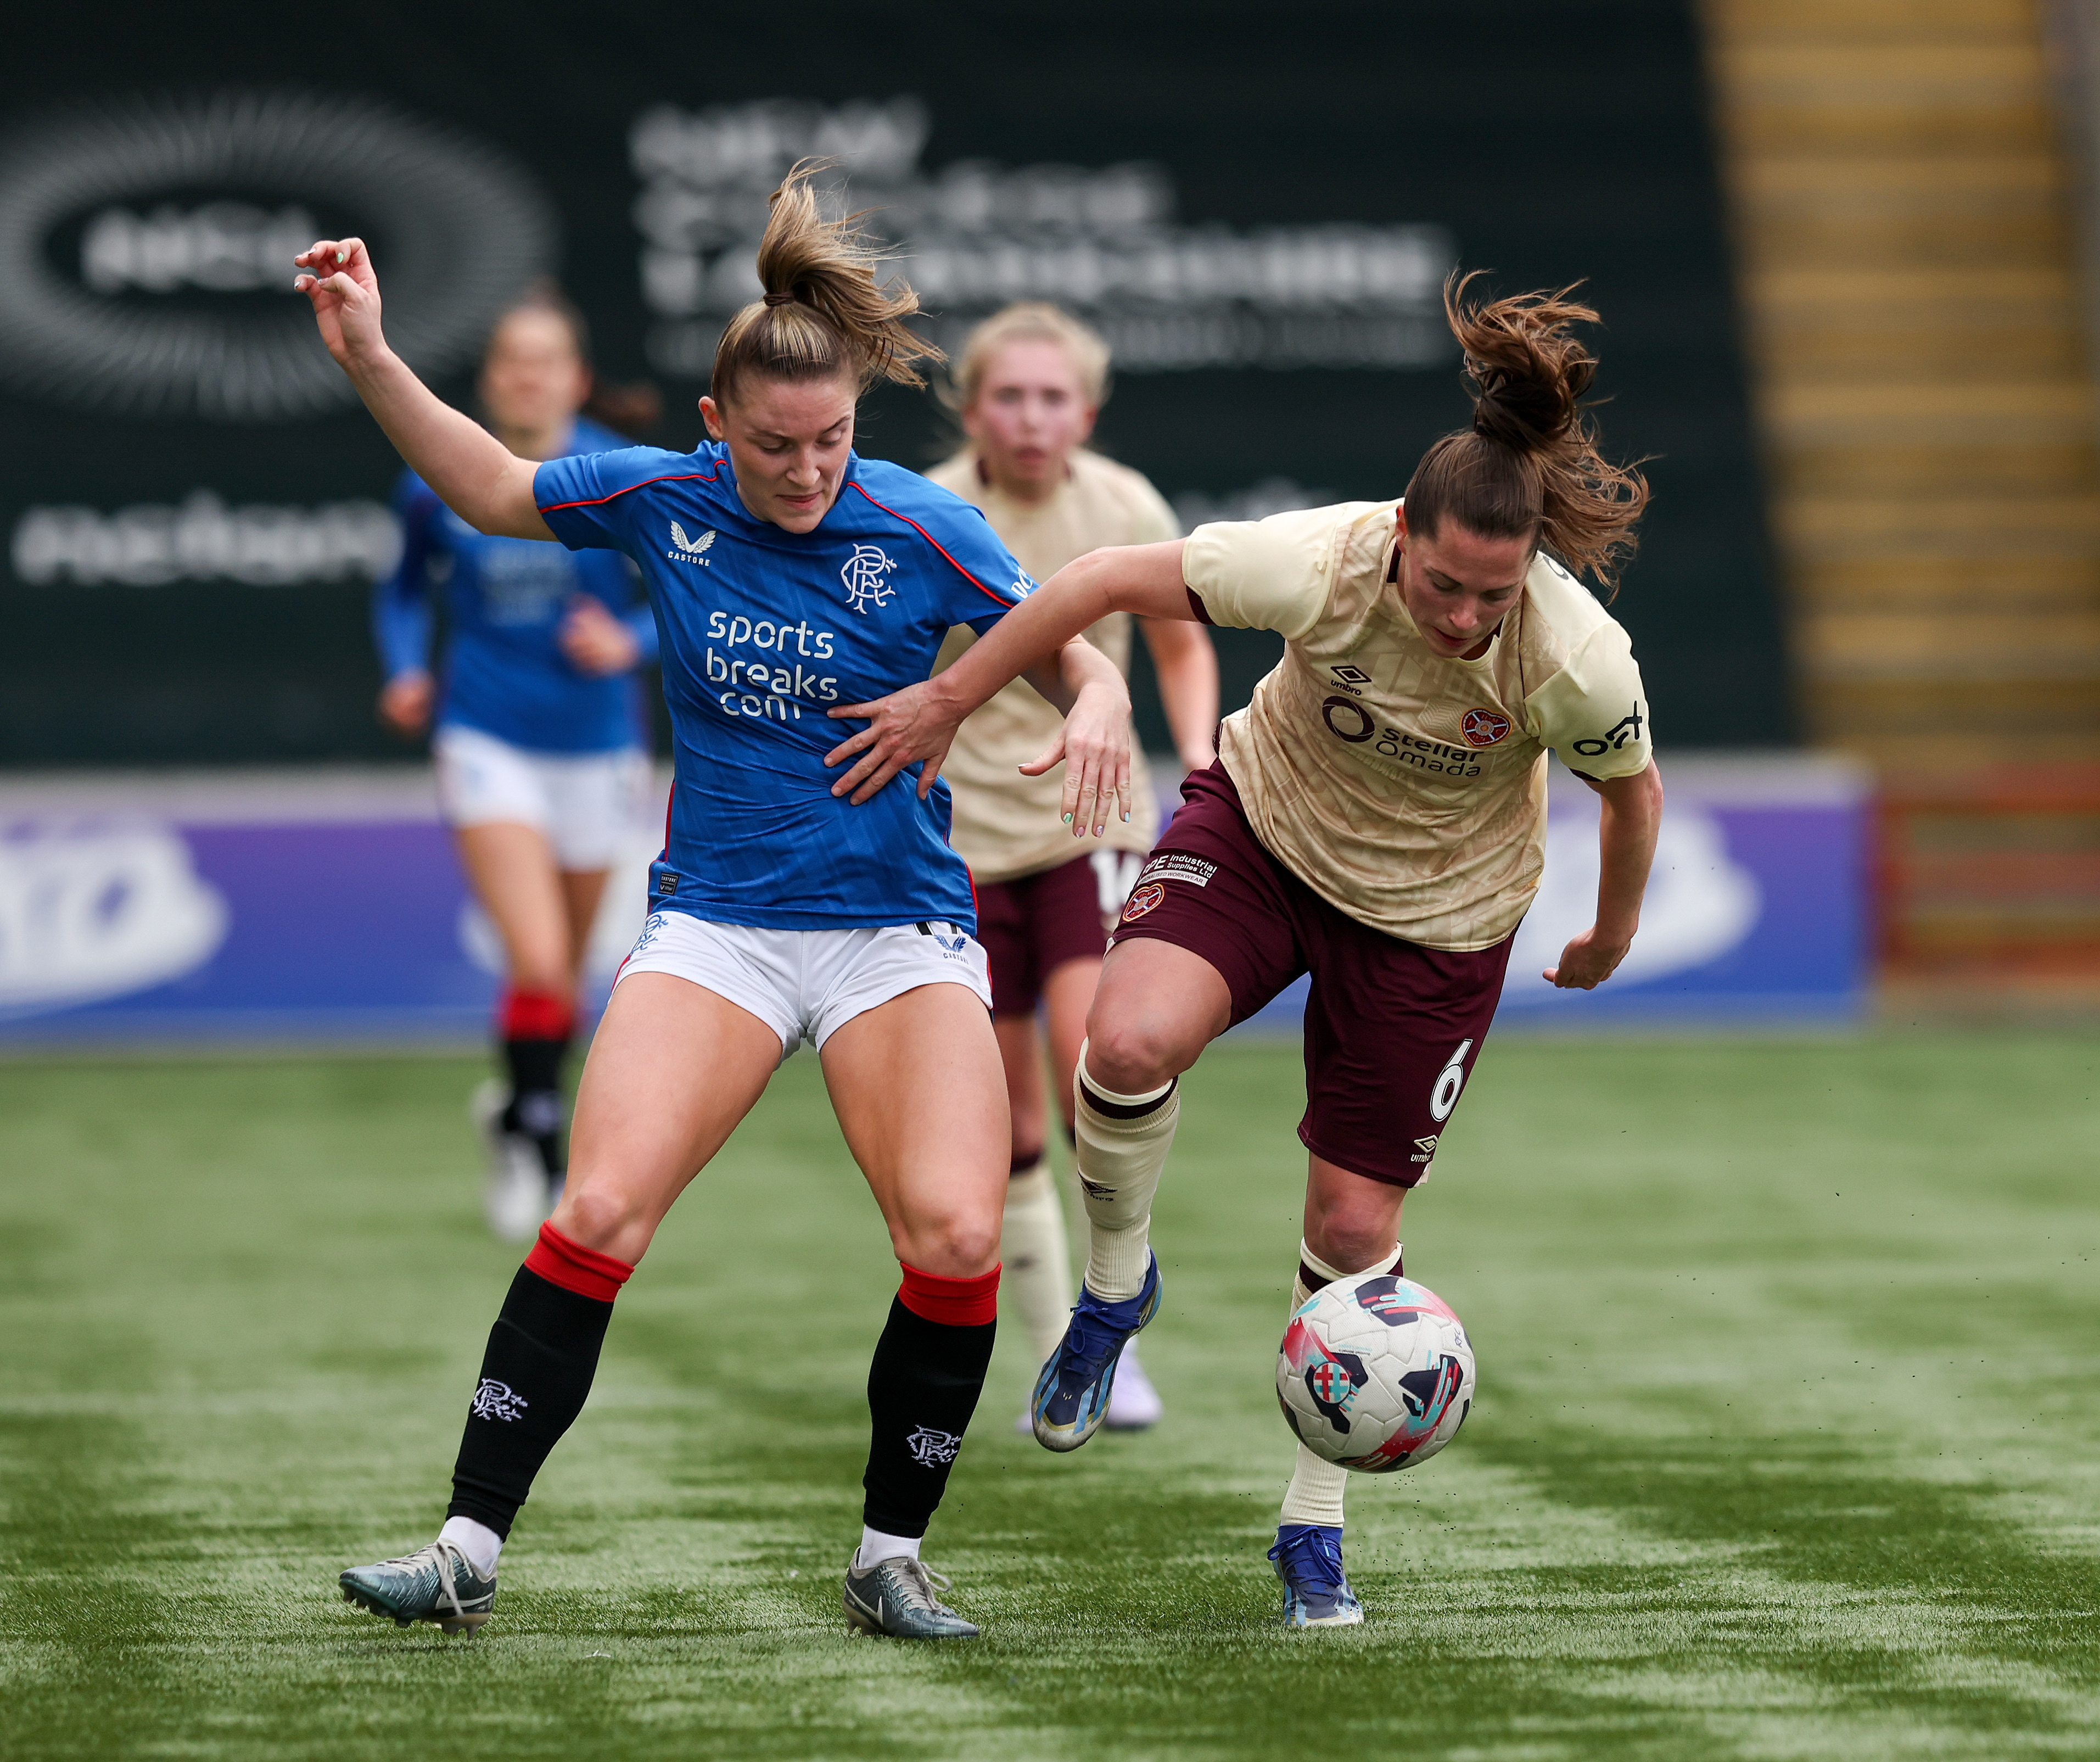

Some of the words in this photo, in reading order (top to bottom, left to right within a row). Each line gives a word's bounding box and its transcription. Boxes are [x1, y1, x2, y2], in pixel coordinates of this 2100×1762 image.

[668, 551, 710, 567] CASTORE
[707, 611, 834, 659] sports
[707, 647, 838, 701] breaks
[1330, 679, 1362, 696] umbro
[1375, 741, 1481, 777] Omada
[1382, 728, 1485, 763] stellar
[1167, 862, 1198, 872] Supplies
[1199, 868, 1213, 879] Ltd
[1169, 854, 1218, 874] Industrial
[1167, 872, 1203, 884] WORKWEAR
[1430, 1038, 1474, 1122] 6
